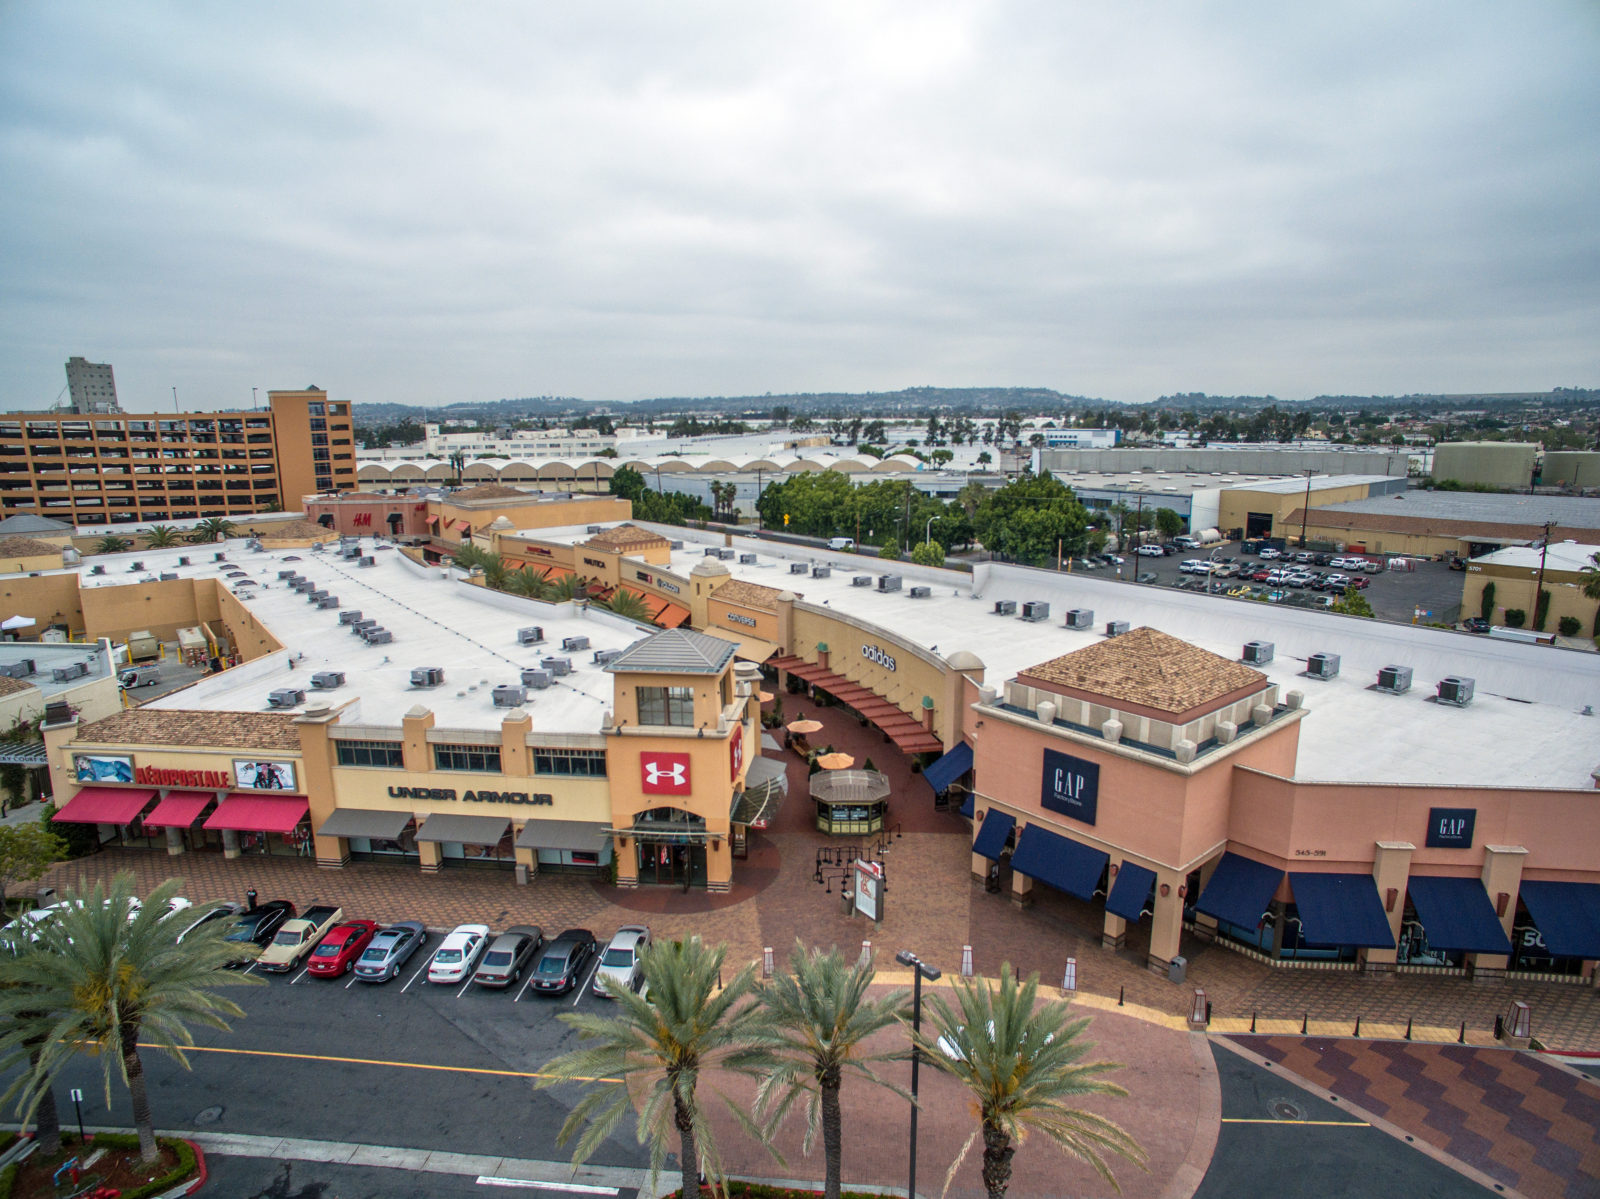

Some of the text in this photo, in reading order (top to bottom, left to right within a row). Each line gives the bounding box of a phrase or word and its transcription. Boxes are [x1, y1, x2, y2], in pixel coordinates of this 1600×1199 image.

[353, 513, 372, 527] H&M
[862, 644, 896, 672] adidas
[1055, 768, 1084, 799] GAP
[388, 786, 553, 806] UNDER ARMOUR
[1440, 818, 1465, 835] GAP
